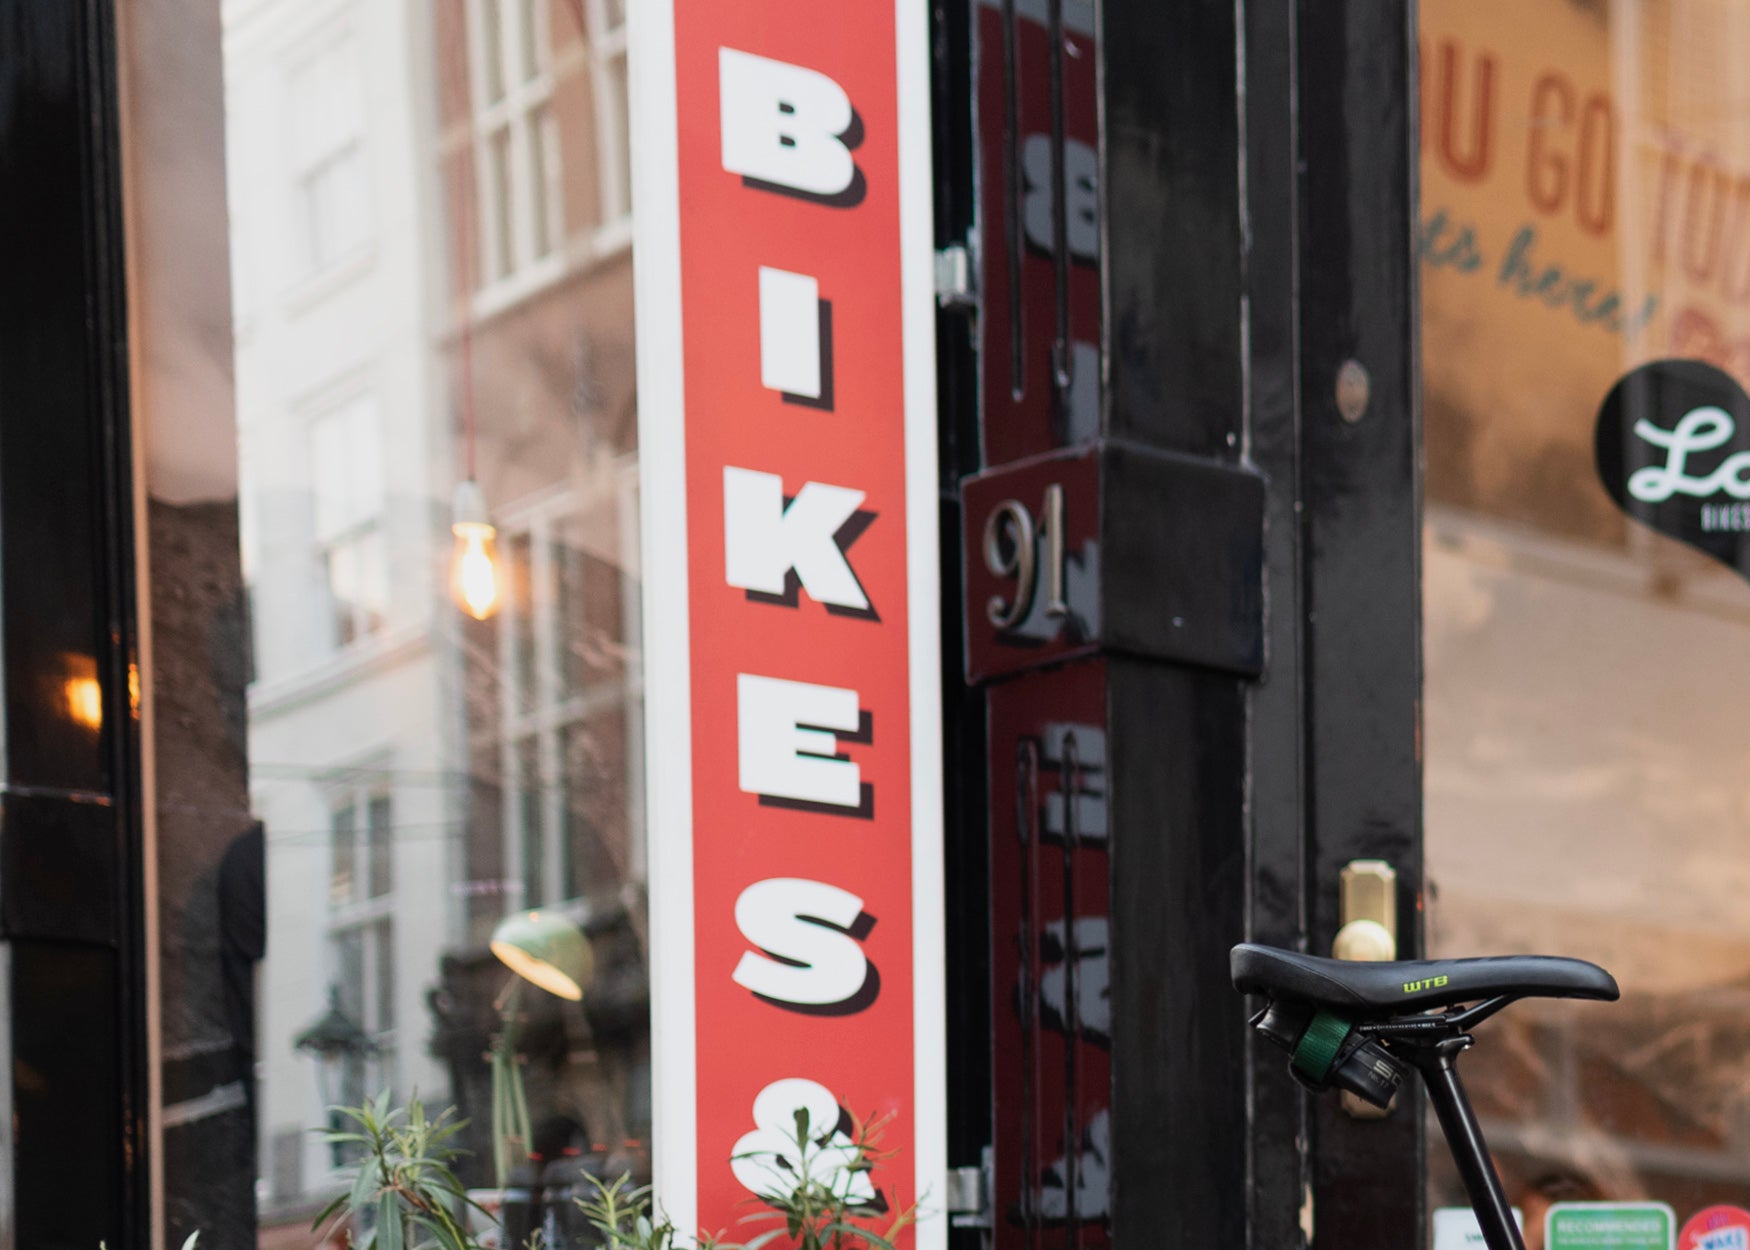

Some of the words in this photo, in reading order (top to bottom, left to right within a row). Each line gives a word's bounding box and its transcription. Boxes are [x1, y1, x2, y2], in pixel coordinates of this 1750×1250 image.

[1524, 70, 1620, 238] GO
[719, 46, 882, 1018] BIKES
[984, 484, 1068, 631] 91
[1402, 975, 1449, 993] WTB
